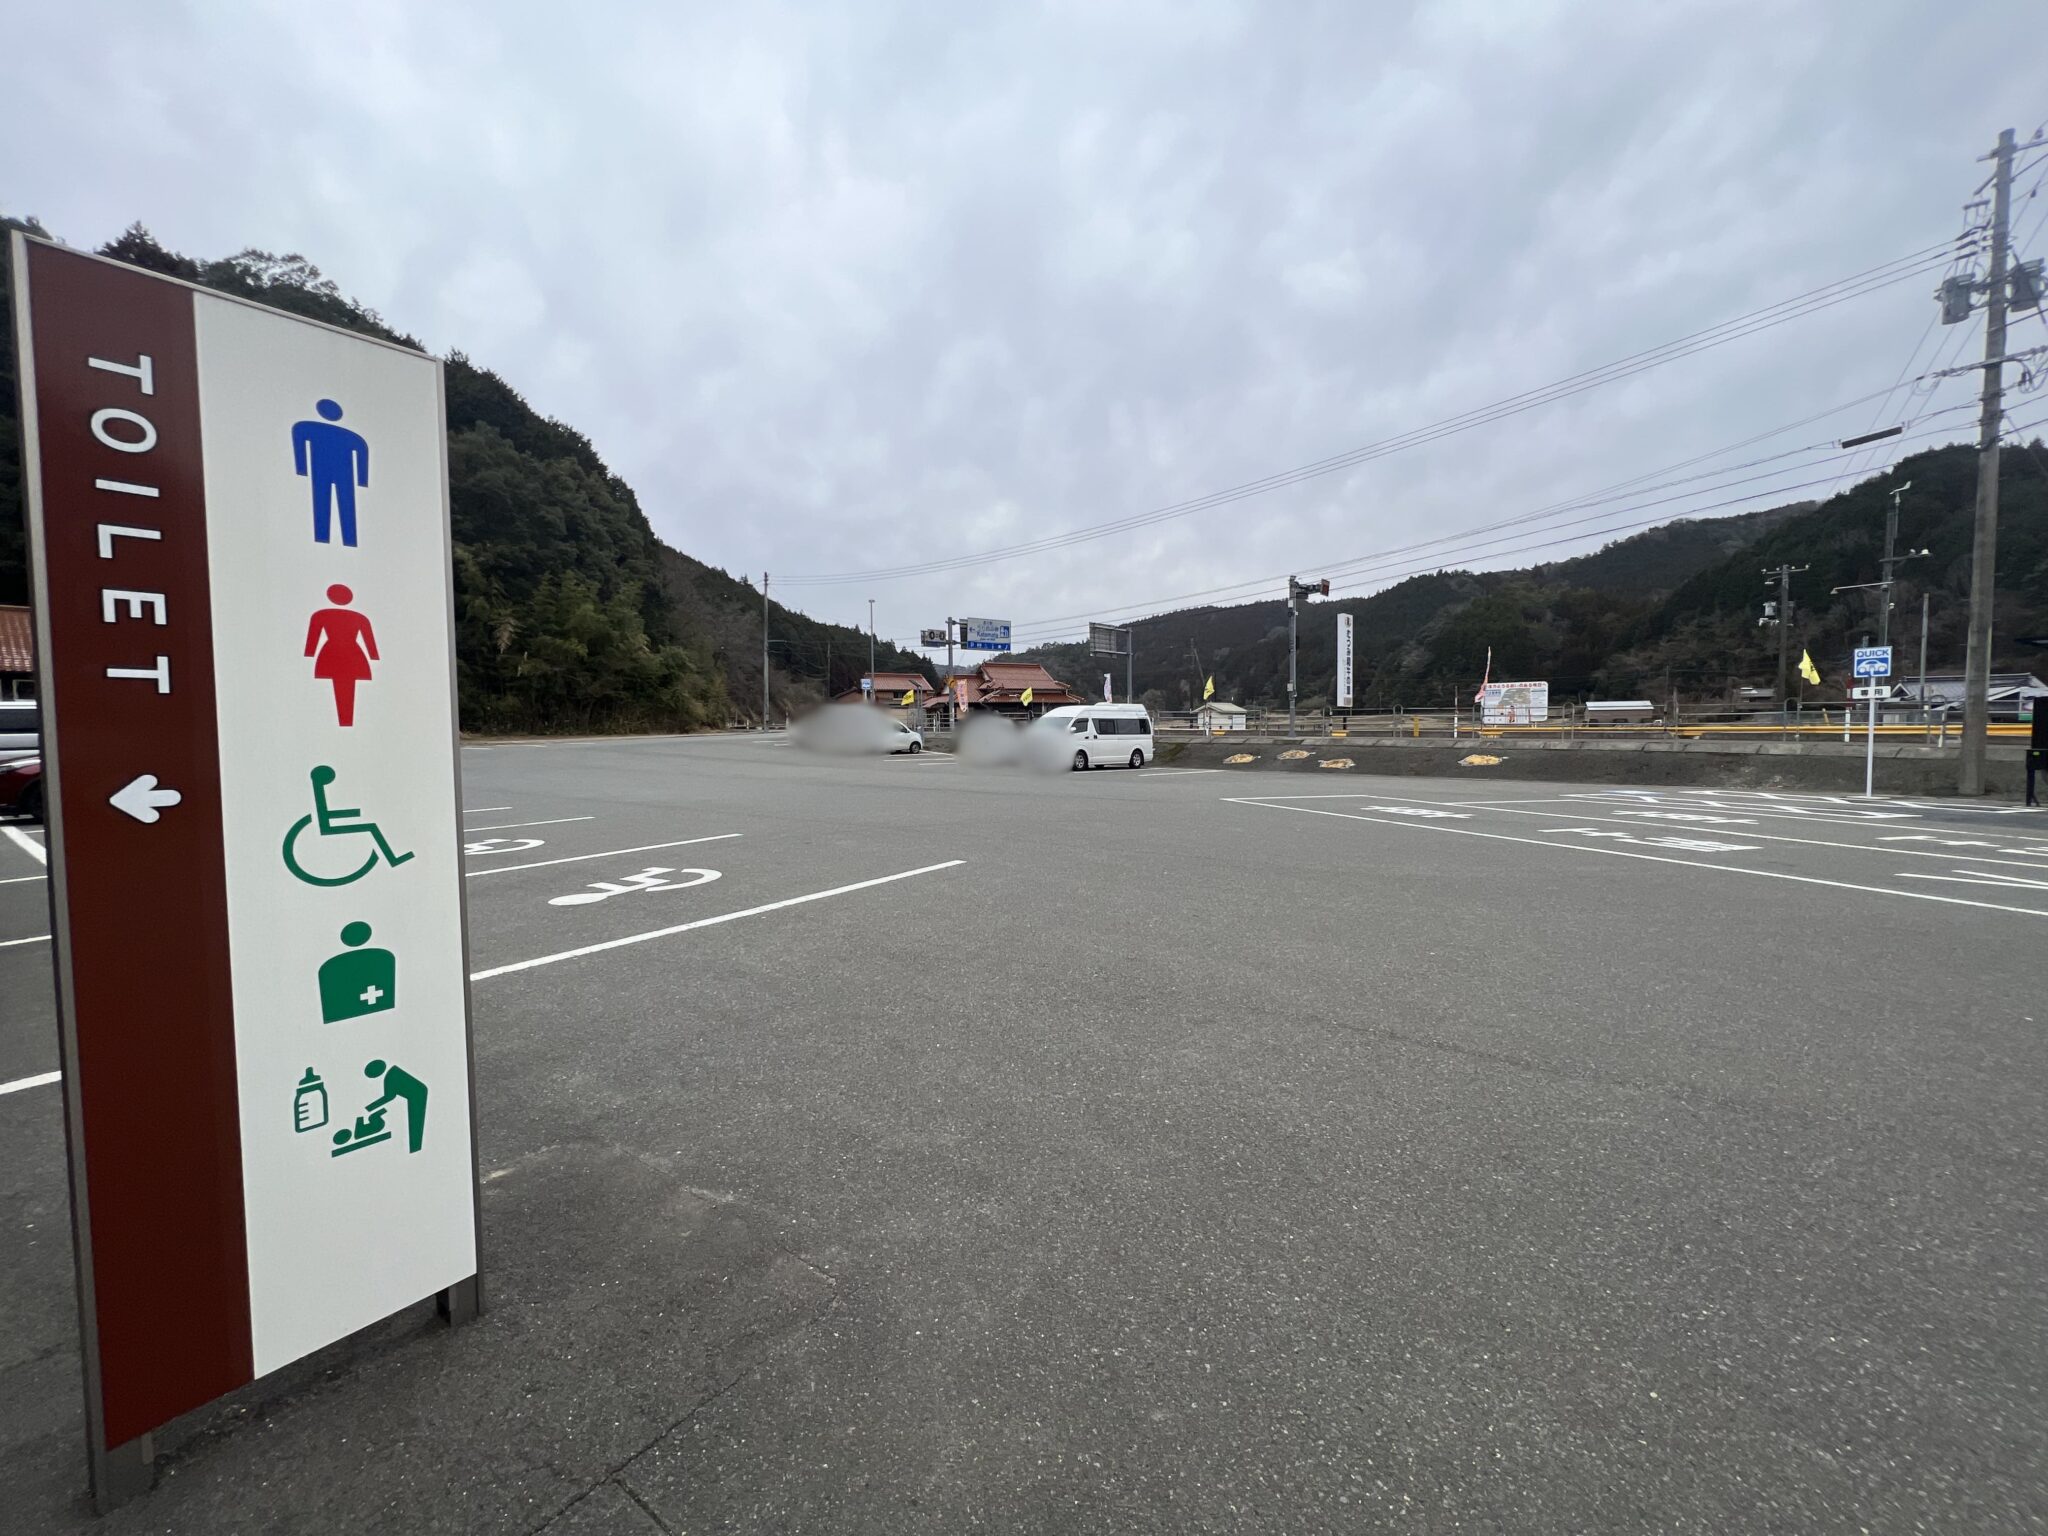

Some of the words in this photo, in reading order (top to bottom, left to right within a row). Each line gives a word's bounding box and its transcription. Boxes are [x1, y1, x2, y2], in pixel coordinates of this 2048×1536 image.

[87, 354, 172, 695] TOILET
[1856, 648, 1890, 658] QUICK
[1860, 688, 1884, 697] 専用
